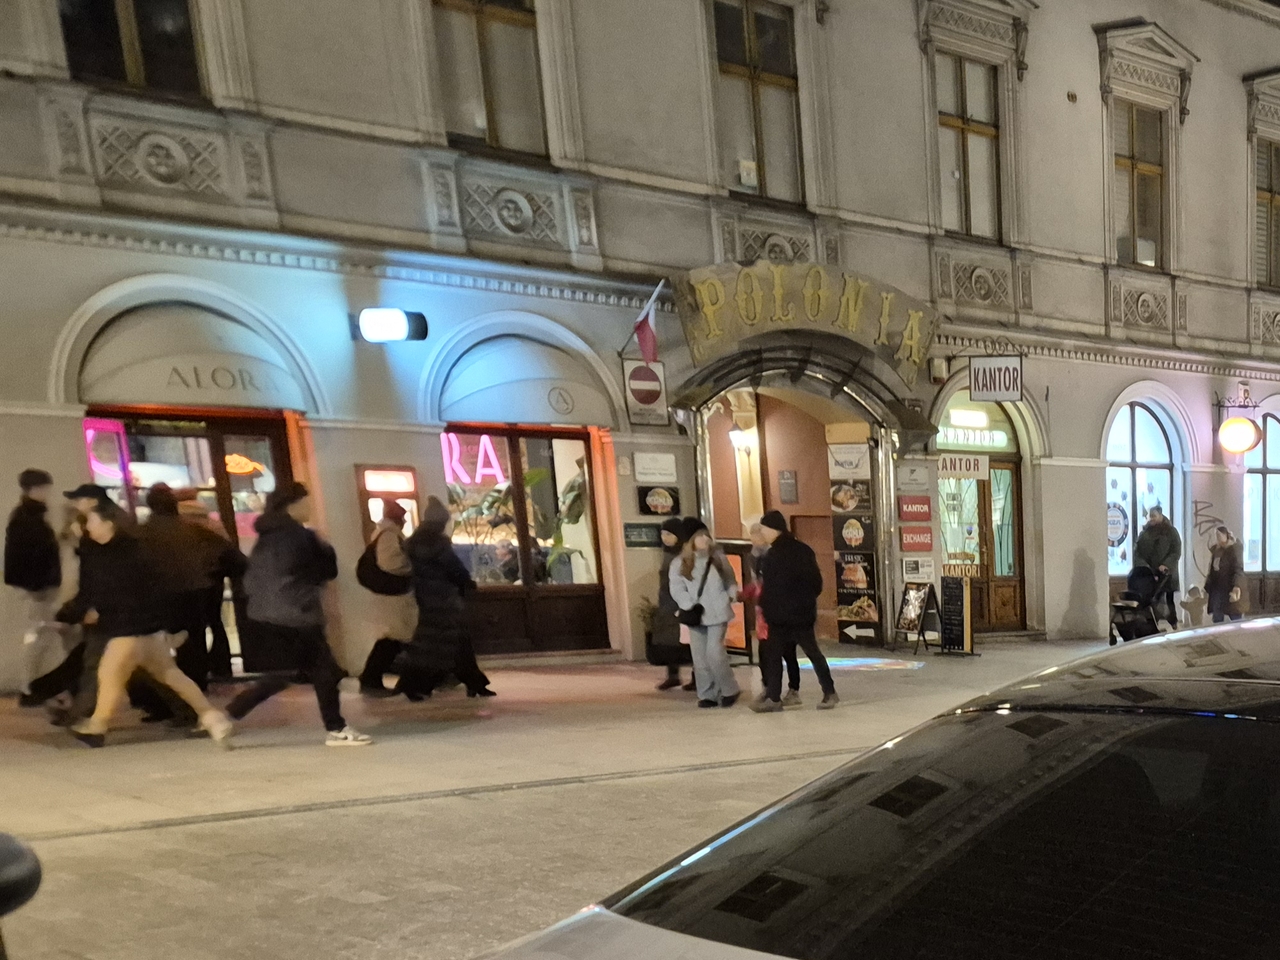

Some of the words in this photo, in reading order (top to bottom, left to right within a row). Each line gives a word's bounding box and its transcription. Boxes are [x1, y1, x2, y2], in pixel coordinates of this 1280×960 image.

[690, 265, 923, 364] POLONIA
[973, 365, 1019, 392] KANTOR
[943, 427, 995, 446] KANTOR
[938, 457, 980, 472] ANTOR
[903, 504, 929, 512] KANTOR
[903, 533, 932, 543] EXCHANGE
[944, 565, 977, 577] KANTOR
